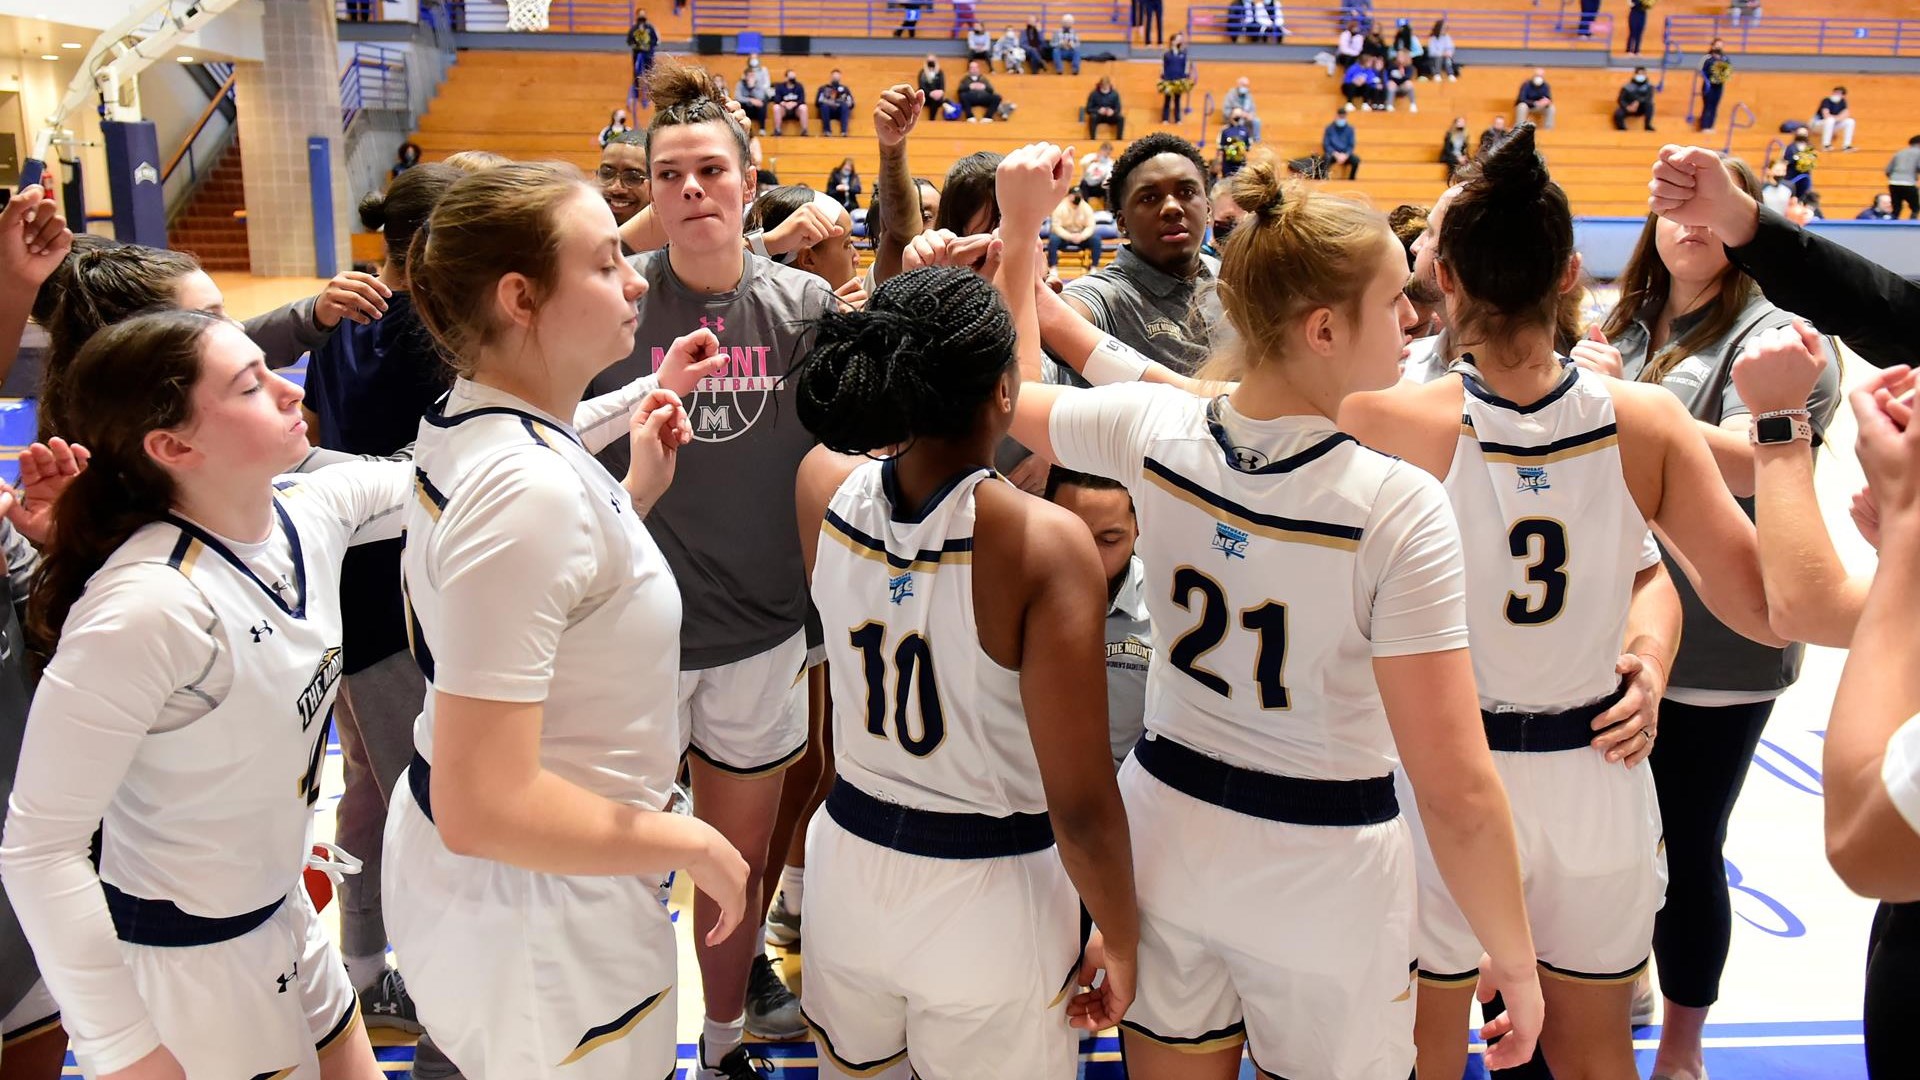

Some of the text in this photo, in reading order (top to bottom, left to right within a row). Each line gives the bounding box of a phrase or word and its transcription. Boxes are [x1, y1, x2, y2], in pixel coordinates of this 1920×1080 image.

[697, 405, 732, 431] M
[1517, 472, 1547, 489] NEC
[1212, 534, 1249, 552] NEC
[1503, 516, 1569, 627] 3
[1106, 643, 1124, 657] THE
[1168, 564, 1292, 711] 21
[298, 673, 324, 727] THE
[848, 618, 948, 759] 10
